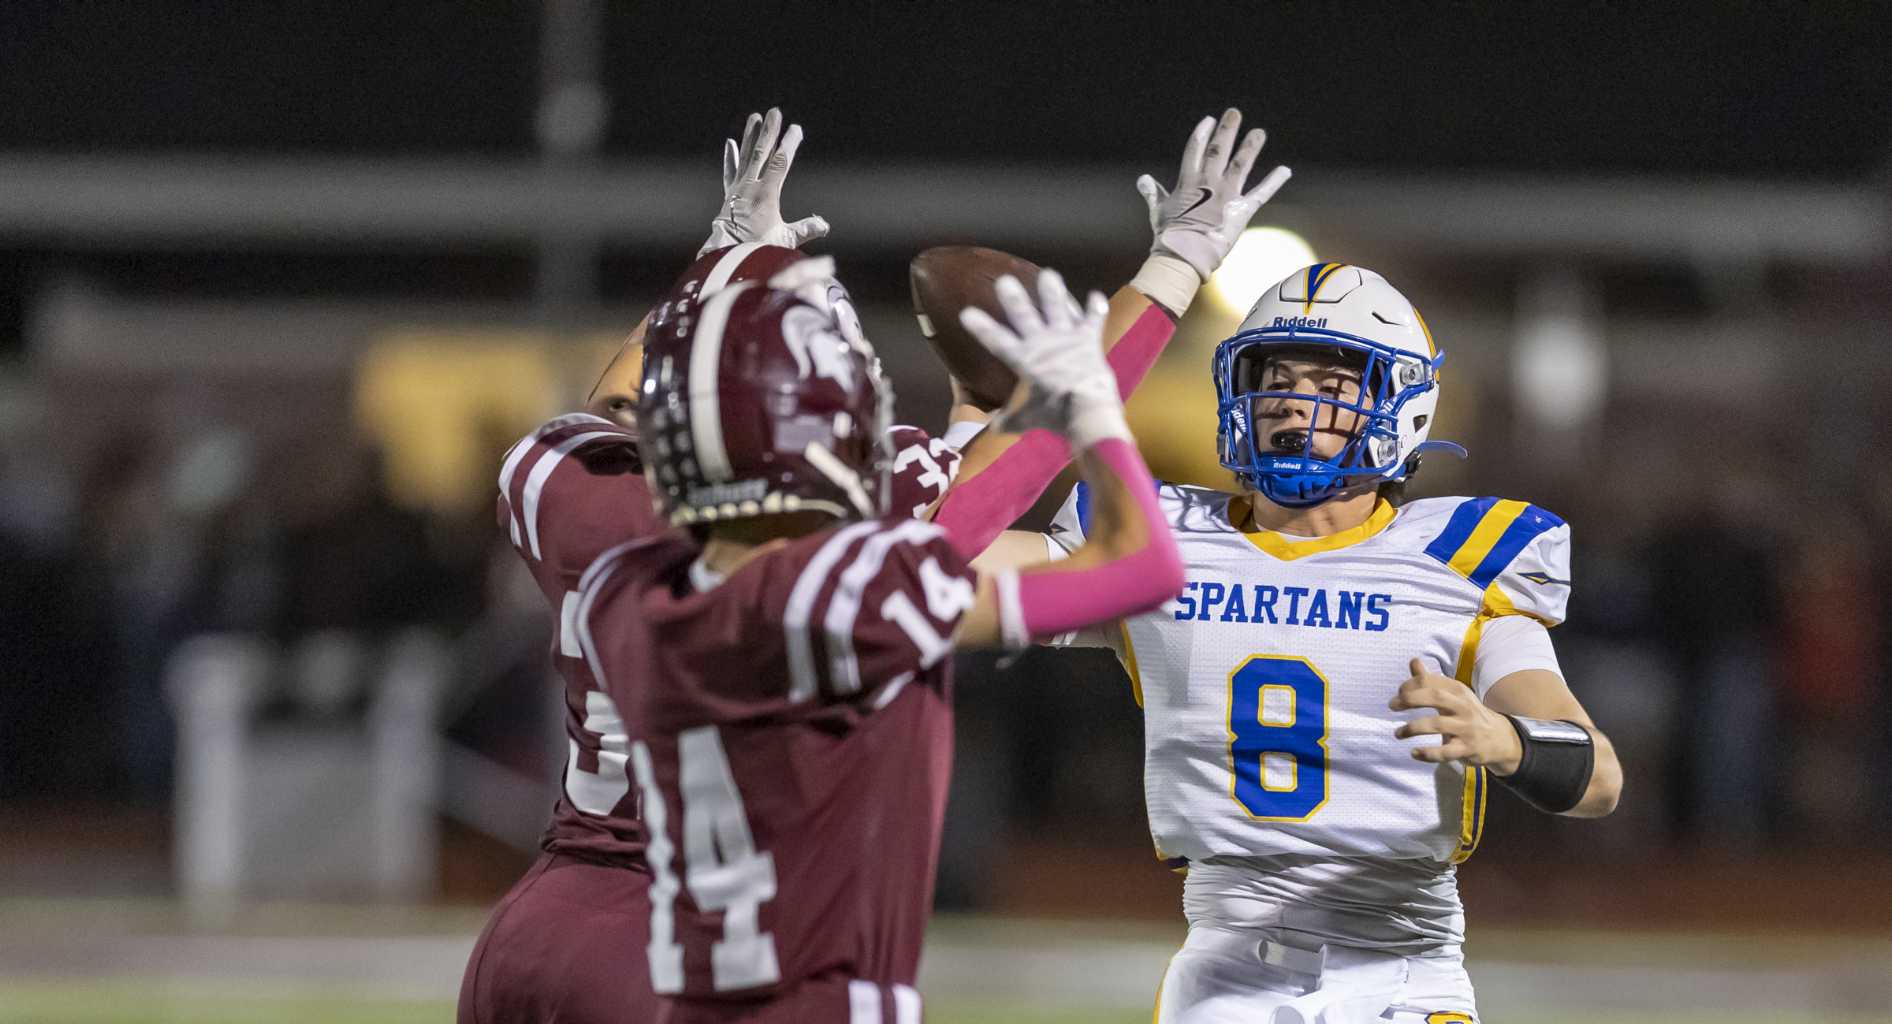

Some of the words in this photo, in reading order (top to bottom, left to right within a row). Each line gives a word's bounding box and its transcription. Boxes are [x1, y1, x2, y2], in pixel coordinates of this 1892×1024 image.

[1272, 316, 1328, 329] Riddell
[881, 556, 975, 670] 14
[1174, 581, 1393, 632] SPARTANS
[1227, 653, 1330, 822] 8
[631, 725, 781, 994] 14
